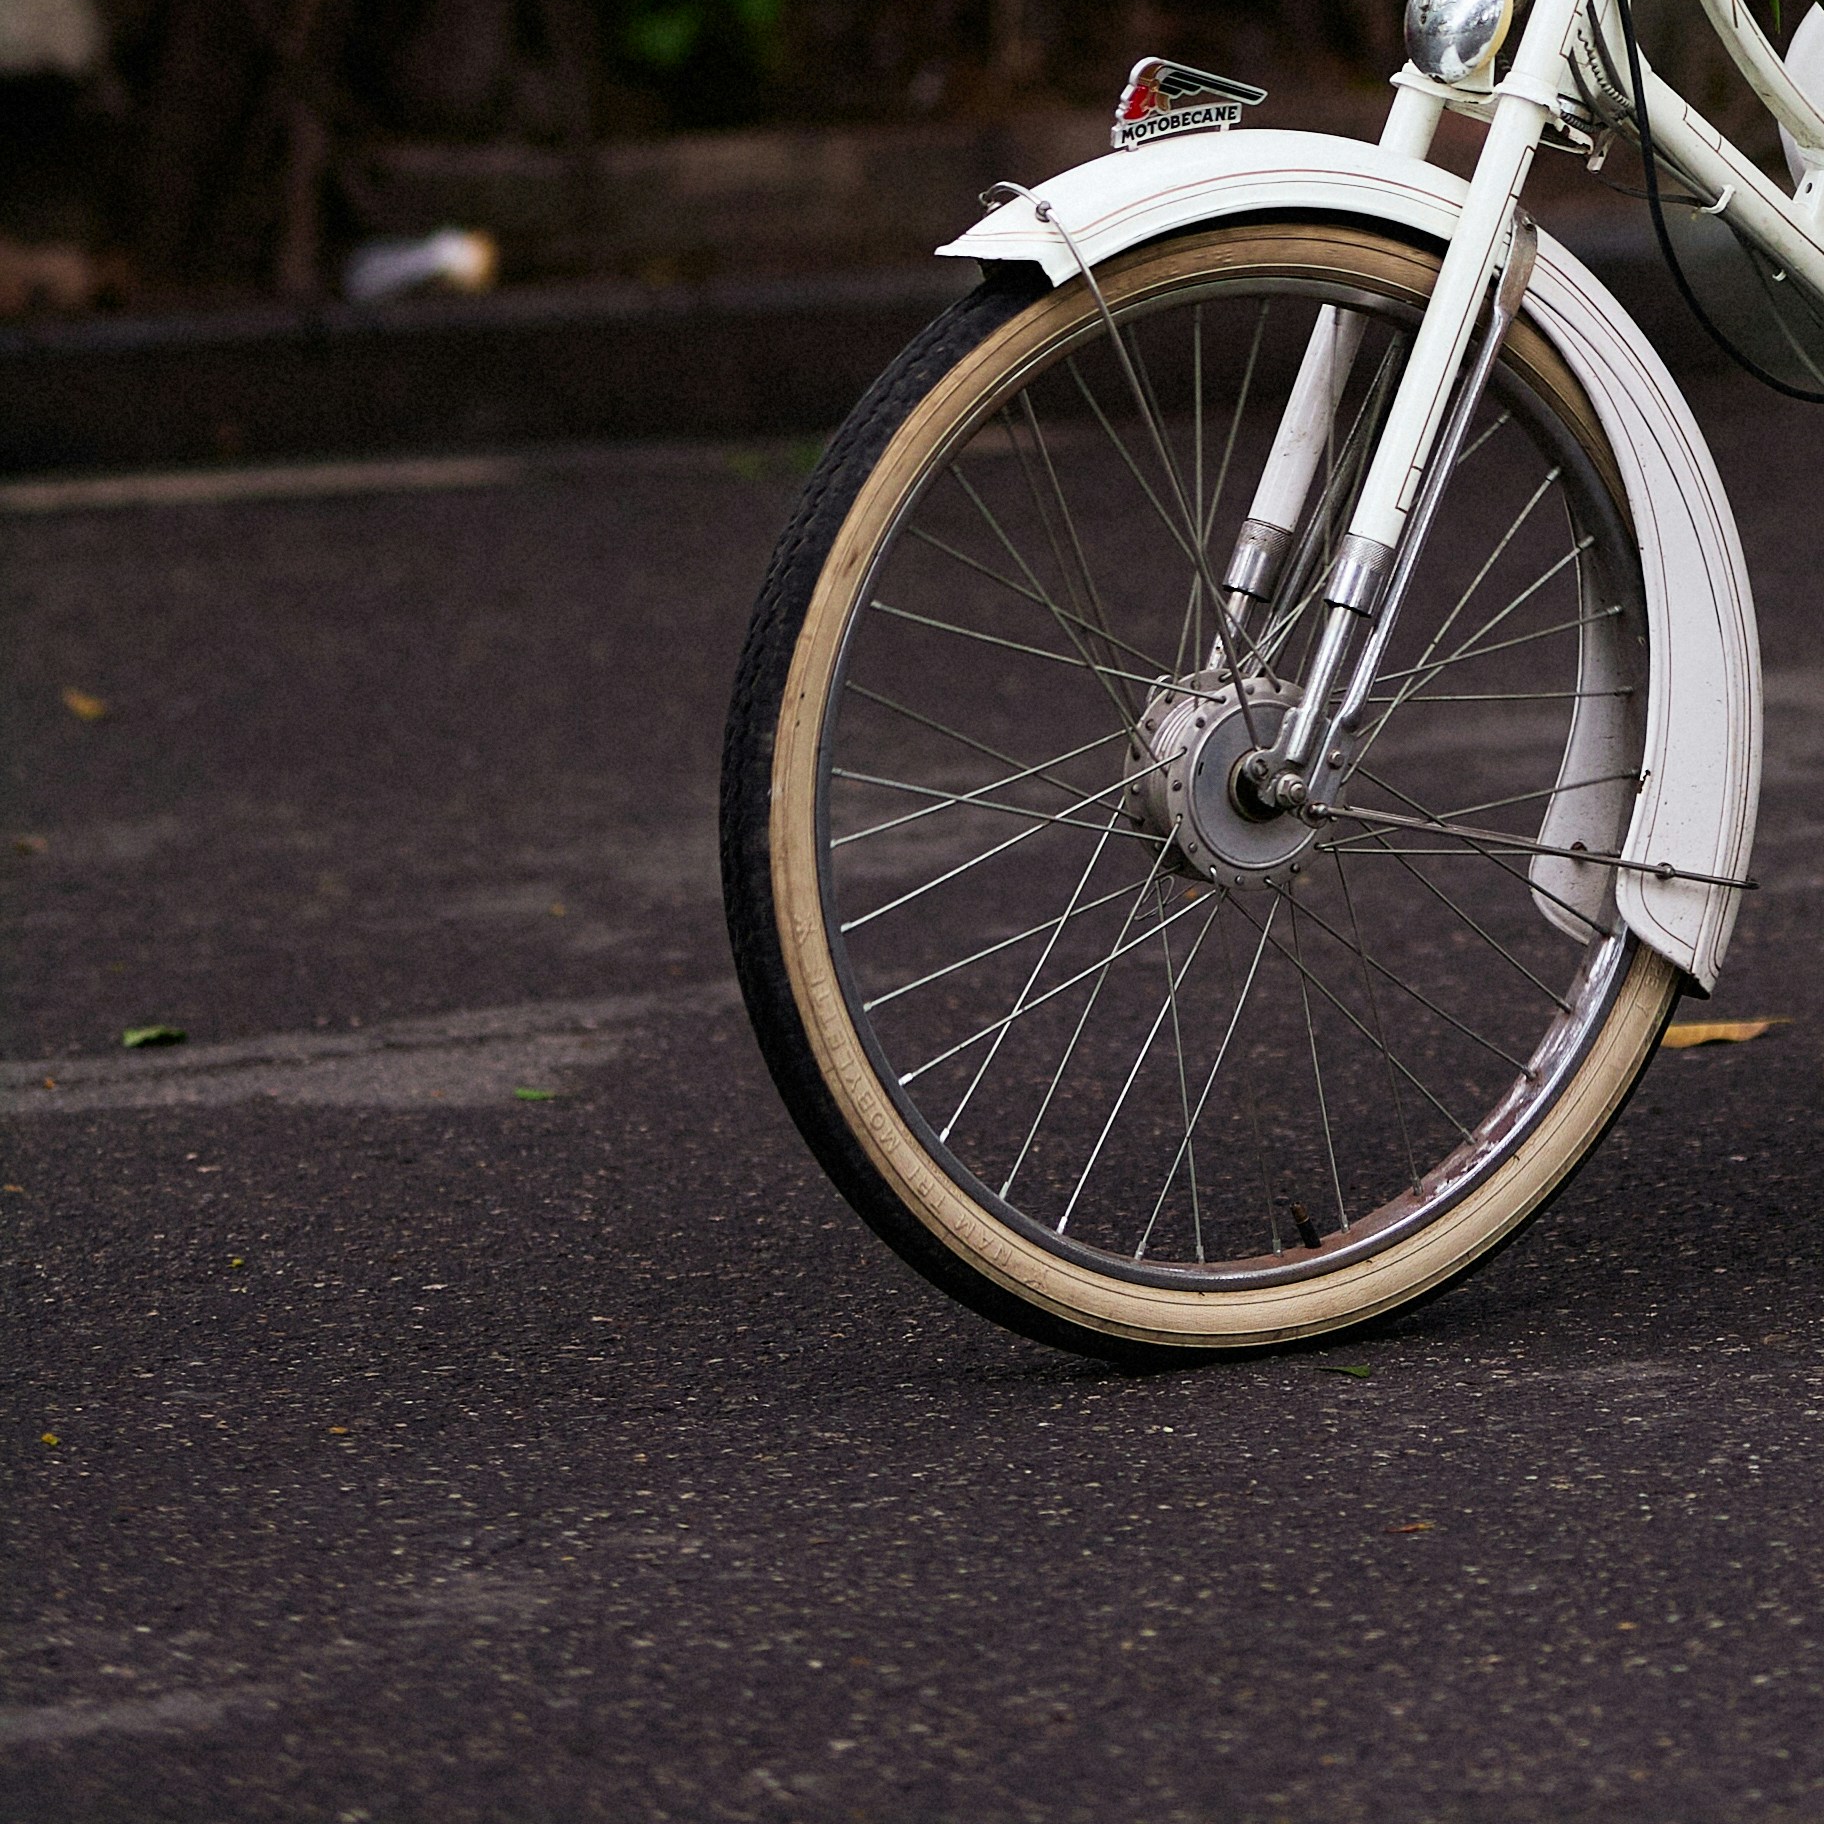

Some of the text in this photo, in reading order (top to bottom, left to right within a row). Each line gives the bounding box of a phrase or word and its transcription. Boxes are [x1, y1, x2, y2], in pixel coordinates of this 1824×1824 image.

[1120, 105, 1238, 144] MOTOBECANE
[907, 1165, 946, 1215] TRI
[954, 1213, 1013, 1267] NAM
